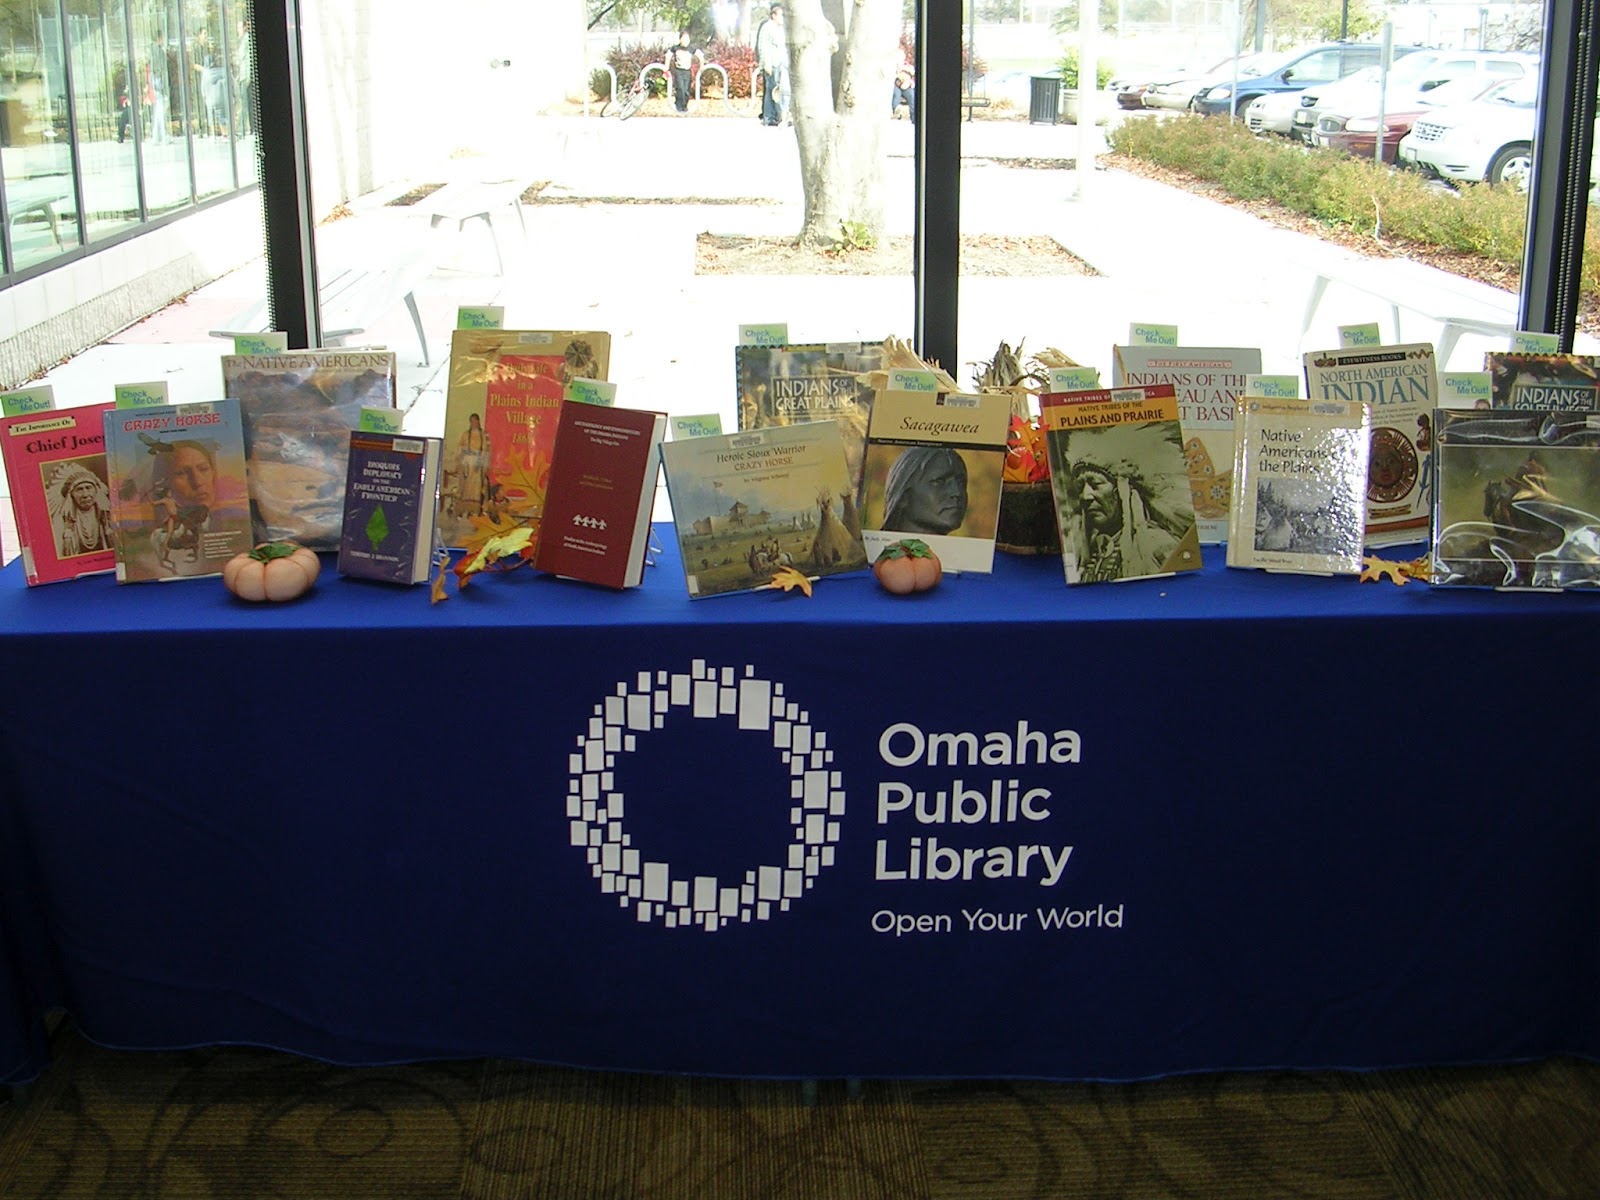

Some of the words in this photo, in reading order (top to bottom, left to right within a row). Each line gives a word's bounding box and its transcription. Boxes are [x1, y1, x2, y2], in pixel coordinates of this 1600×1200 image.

[1136, 328, 1160, 336] Check
[1343, 331, 1364, 339] Check
[1158, 336, 1174, 344] Out!
[242, 355, 298, 369] NATIVE
[300, 354, 389, 368] AMERICANS
[1344, 356, 1380, 364] EYEWITNESS
[895, 374, 920, 382] Check
[1127, 373, 1191, 386] INDIANS
[1196, 373, 1216, 386] OF
[1320, 370, 1362, 383] NORTH
[1366, 364, 1428, 380] AMERICAN
[776, 379, 840, 397] INDIANS
[1067, 382, 1079, 390] Me
[1254, 381, 1279, 389] Check
[1446, 378, 1472, 386] Check
[122, 390, 148, 398] Check
[577, 386, 598, 396] Check
[1321, 376, 1430, 406] INDIAN
[1457, 386, 1470, 394] Me
[1471, 386, 1488, 394] Out!
[1516, 388, 1580, 404] INDIANS
[8, 396, 32, 406] Check
[148, 396, 163, 404] Out!
[490, 394, 522, 407] Plains
[525, 394, 559, 408] Indian
[596, 397, 610, 405] Out!
[776, 396, 812, 410] GREAT
[814, 396, 854, 410] PLAINS
[1210, 390, 1246, 404] AN
[20, 403, 32, 412] Me
[34, 400, 50, 410] Out!
[366, 413, 386, 422] Check
[1060, 414, 1098, 426] PLAINS
[1100, 412, 1122, 424] AND
[1124, 409, 1164, 422] PRAIRIE
[1197, 406, 1234, 421] BASI
[124, 416, 170, 432] CRAZY
[175, 413, 220, 426] HORSE
[384, 424, 398, 432] Out!
[678, 422, 703, 430] Check
[900, 416, 980, 436] Sacagawea
[703, 427, 720, 435] Out!
[1262, 429, 1302, 442] Native
[26, 436, 68, 454] Chief
[71, 434, 106, 450] Jose
[716, 451, 744, 463] Heroic
[747, 449, 771, 459] Sioux
[772, 444, 806, 456] Warrior
[1259, 445, 1328, 459] Americans
[734, 460, 762, 471] CRAZY
[764, 457, 794, 468] HORSE
[1259, 459, 1280, 472] the
[1282, 460, 1321, 474] Plains
[878, 720, 1081, 767] Omaha
[878, 779, 1052, 824] Public
[875, 837, 1074, 886] Library
[872, 910, 952, 936] Open
[961, 908, 1028, 931] Your
[1036, 904, 1124, 930] World
